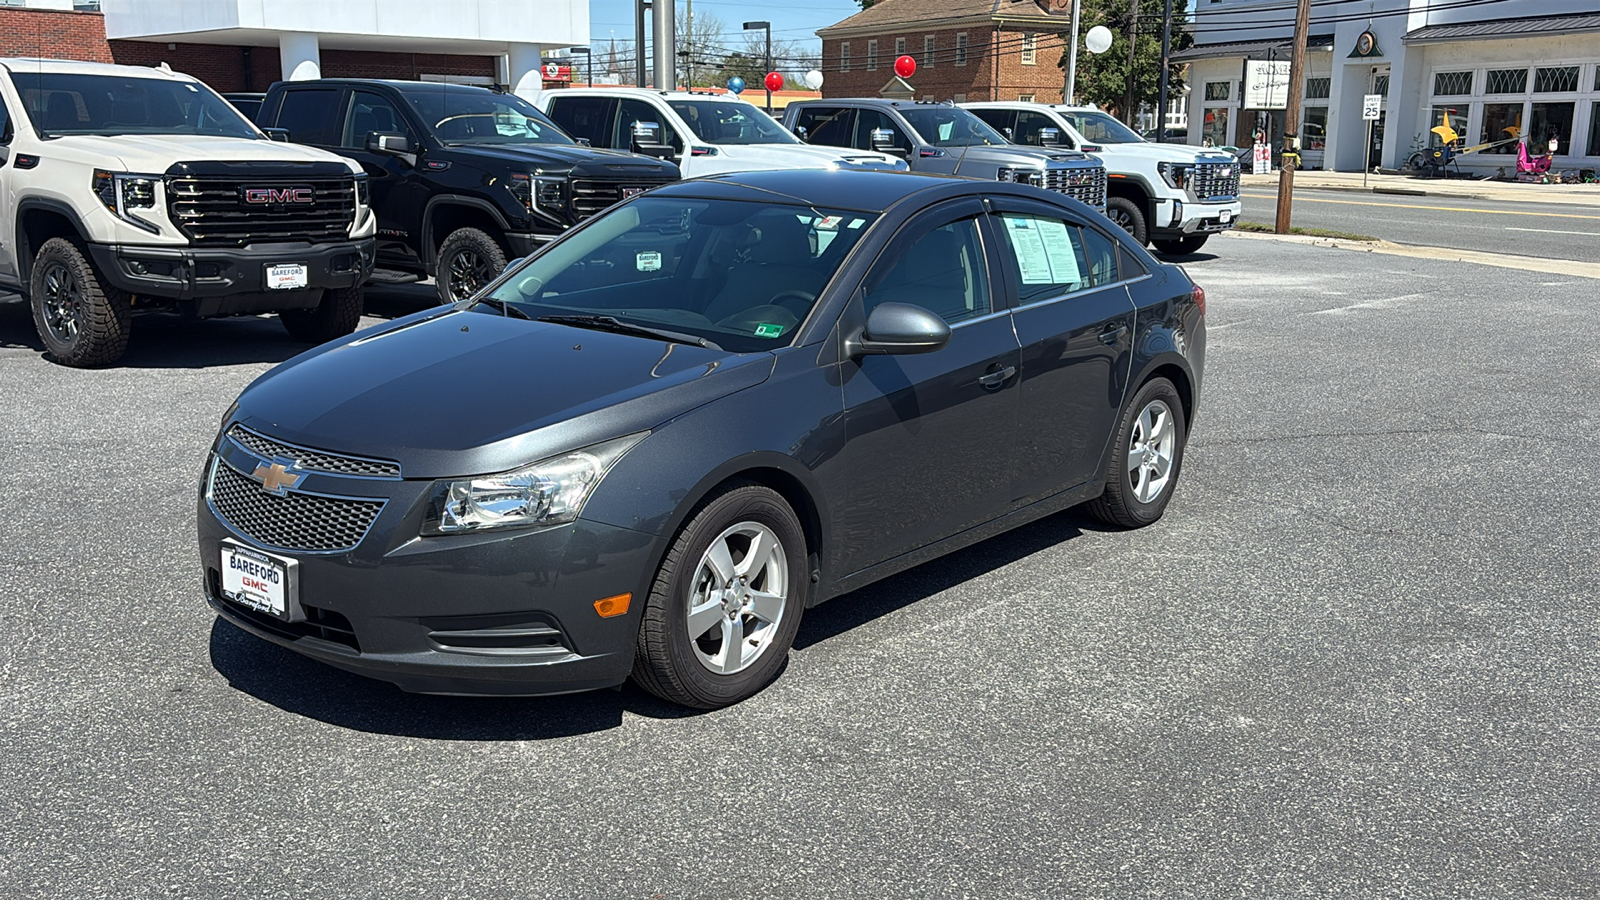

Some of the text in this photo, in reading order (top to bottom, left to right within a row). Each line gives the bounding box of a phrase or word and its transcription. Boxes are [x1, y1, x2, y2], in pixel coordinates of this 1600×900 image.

[1365, 107, 1378, 117] 25
[246, 188, 313, 204] GMC
[271, 268, 304, 277] BAREFORD
[230, 555, 279, 584] BAREFORD
[242, 576, 269, 593] GMC
[234, 591, 273, 613] Bareford
